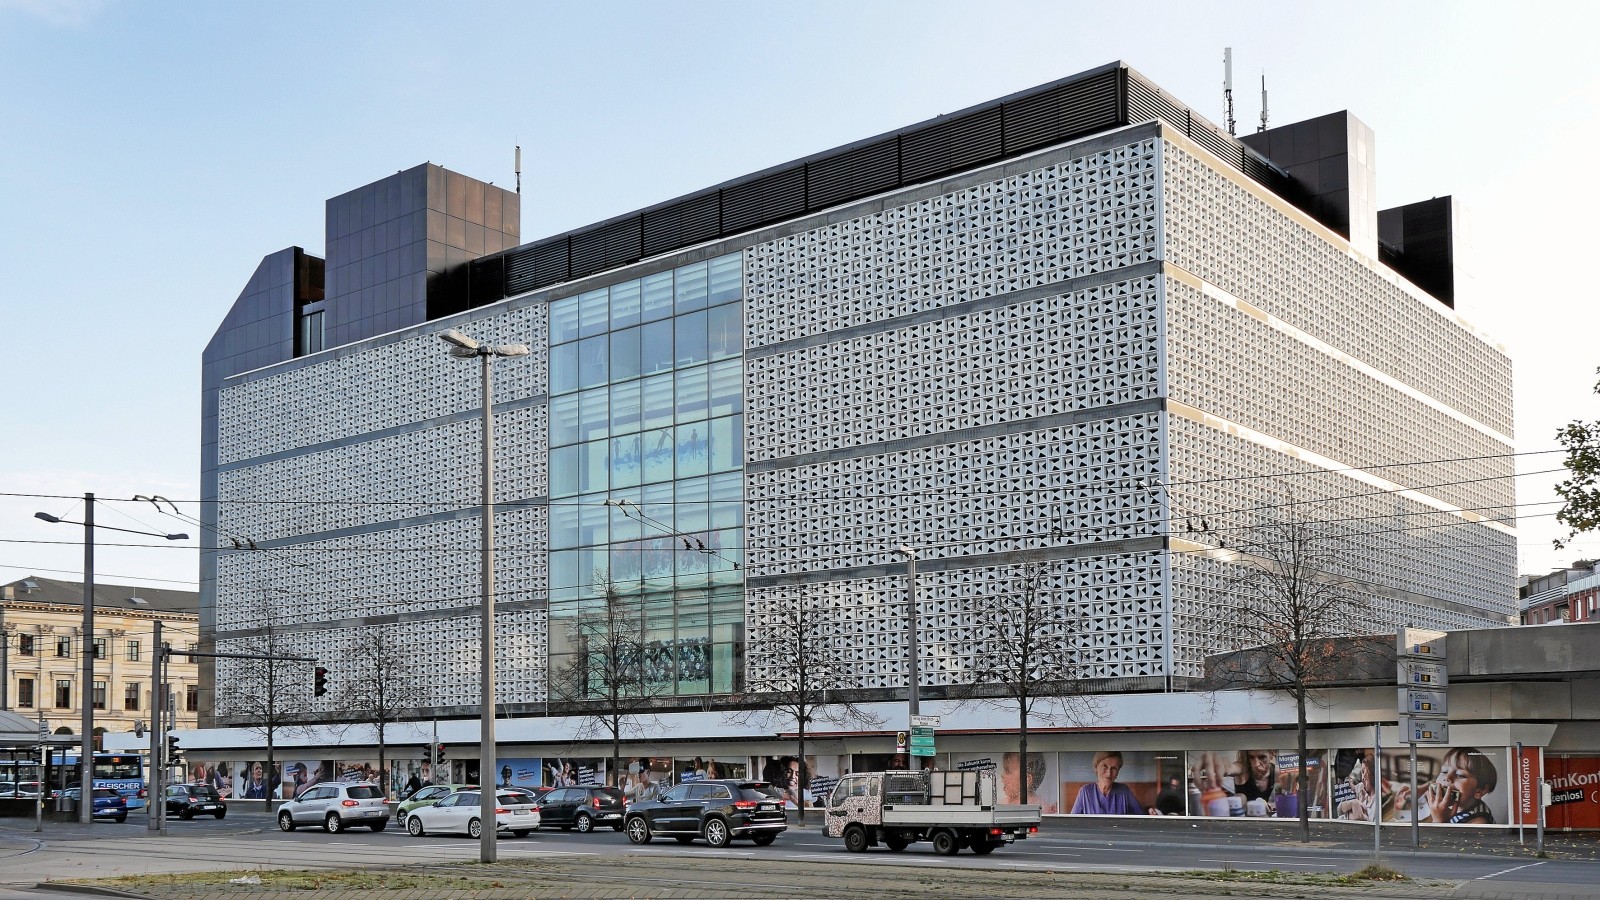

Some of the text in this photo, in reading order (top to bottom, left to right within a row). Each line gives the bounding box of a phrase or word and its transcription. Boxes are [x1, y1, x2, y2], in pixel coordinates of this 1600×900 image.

[1279, 754, 1299, 763] Morgen
[106, 782, 140, 790] FISCHER
[1522, 758, 1531, 814] #MeinKonto
